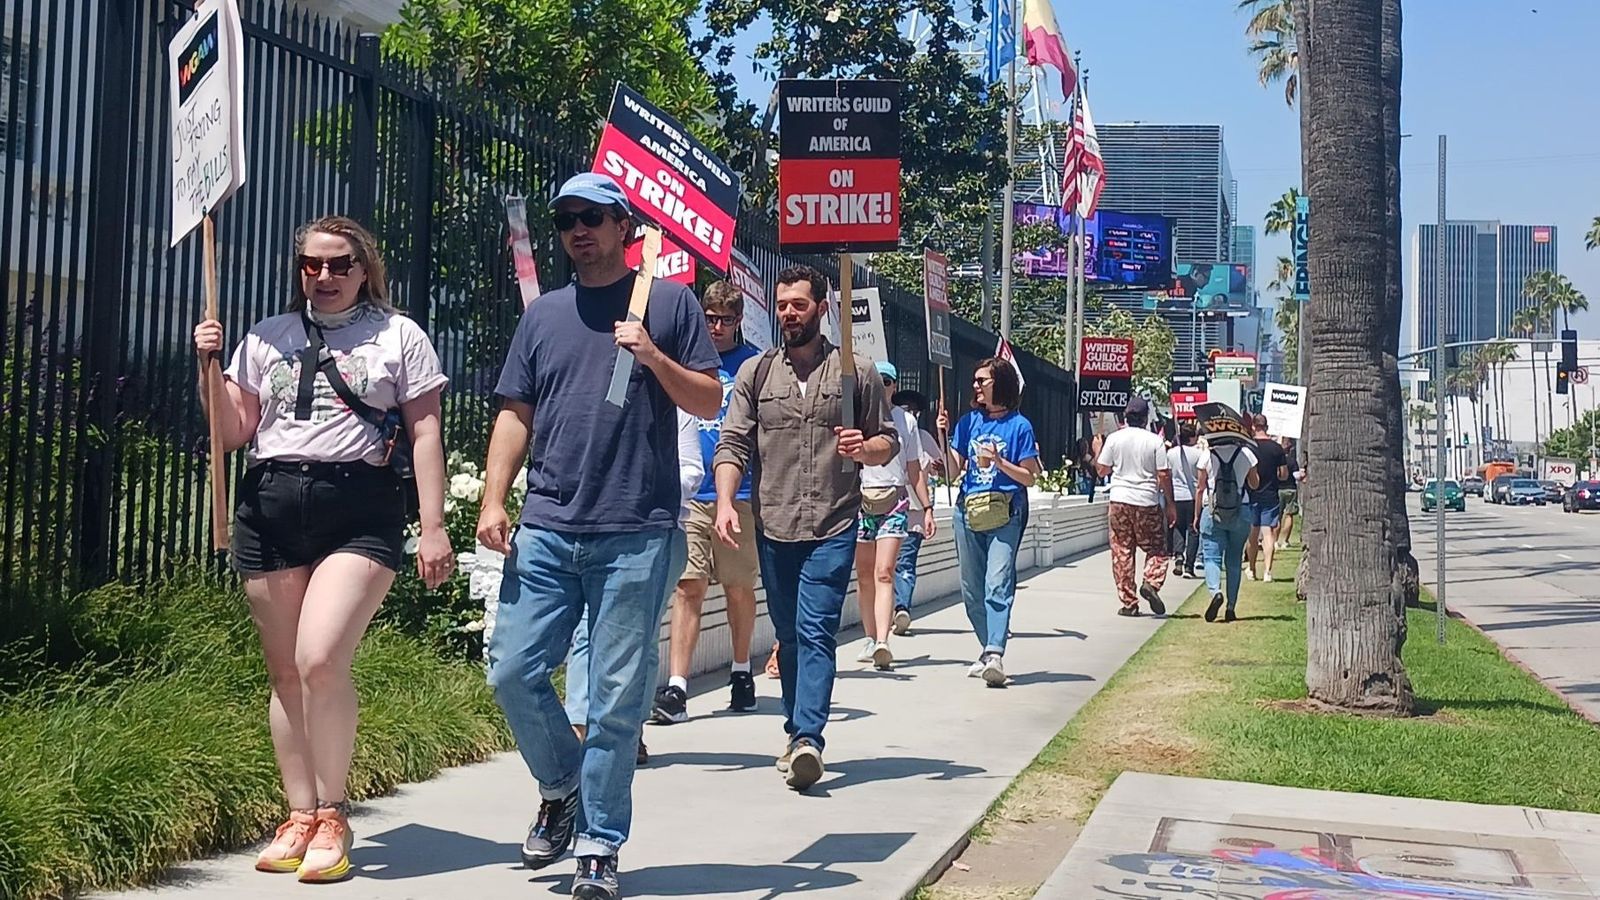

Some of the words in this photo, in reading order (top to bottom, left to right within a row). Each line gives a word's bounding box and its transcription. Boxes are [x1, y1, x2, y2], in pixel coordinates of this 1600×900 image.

[786, 97, 850, 113] WRITERS
[853, 97, 891, 113] GUILD
[175, 101, 197, 163] JUST
[833, 118, 848, 131] OF
[623, 94, 691, 151] WRITERS
[692, 147, 732, 187] GUILD
[809, 136, 871, 152] AMERICA
[669, 142, 687, 158] OF
[640, 134, 707, 192] AMERICA
[656, 169, 686, 197] ON
[829, 169, 854, 188] ON
[602, 150, 724, 254] STRIKE!
[786, 192, 892, 225] STRIKE!
[1085, 342, 1129, 354] WRITERS
[1086, 352, 1117, 362] GUILD
[1083, 361, 1129, 373] AMERICA
[1098, 379, 1111, 392] ON
[1080, 390, 1128, 407] STRIKE
[1550, 465, 1572, 474] XPO
